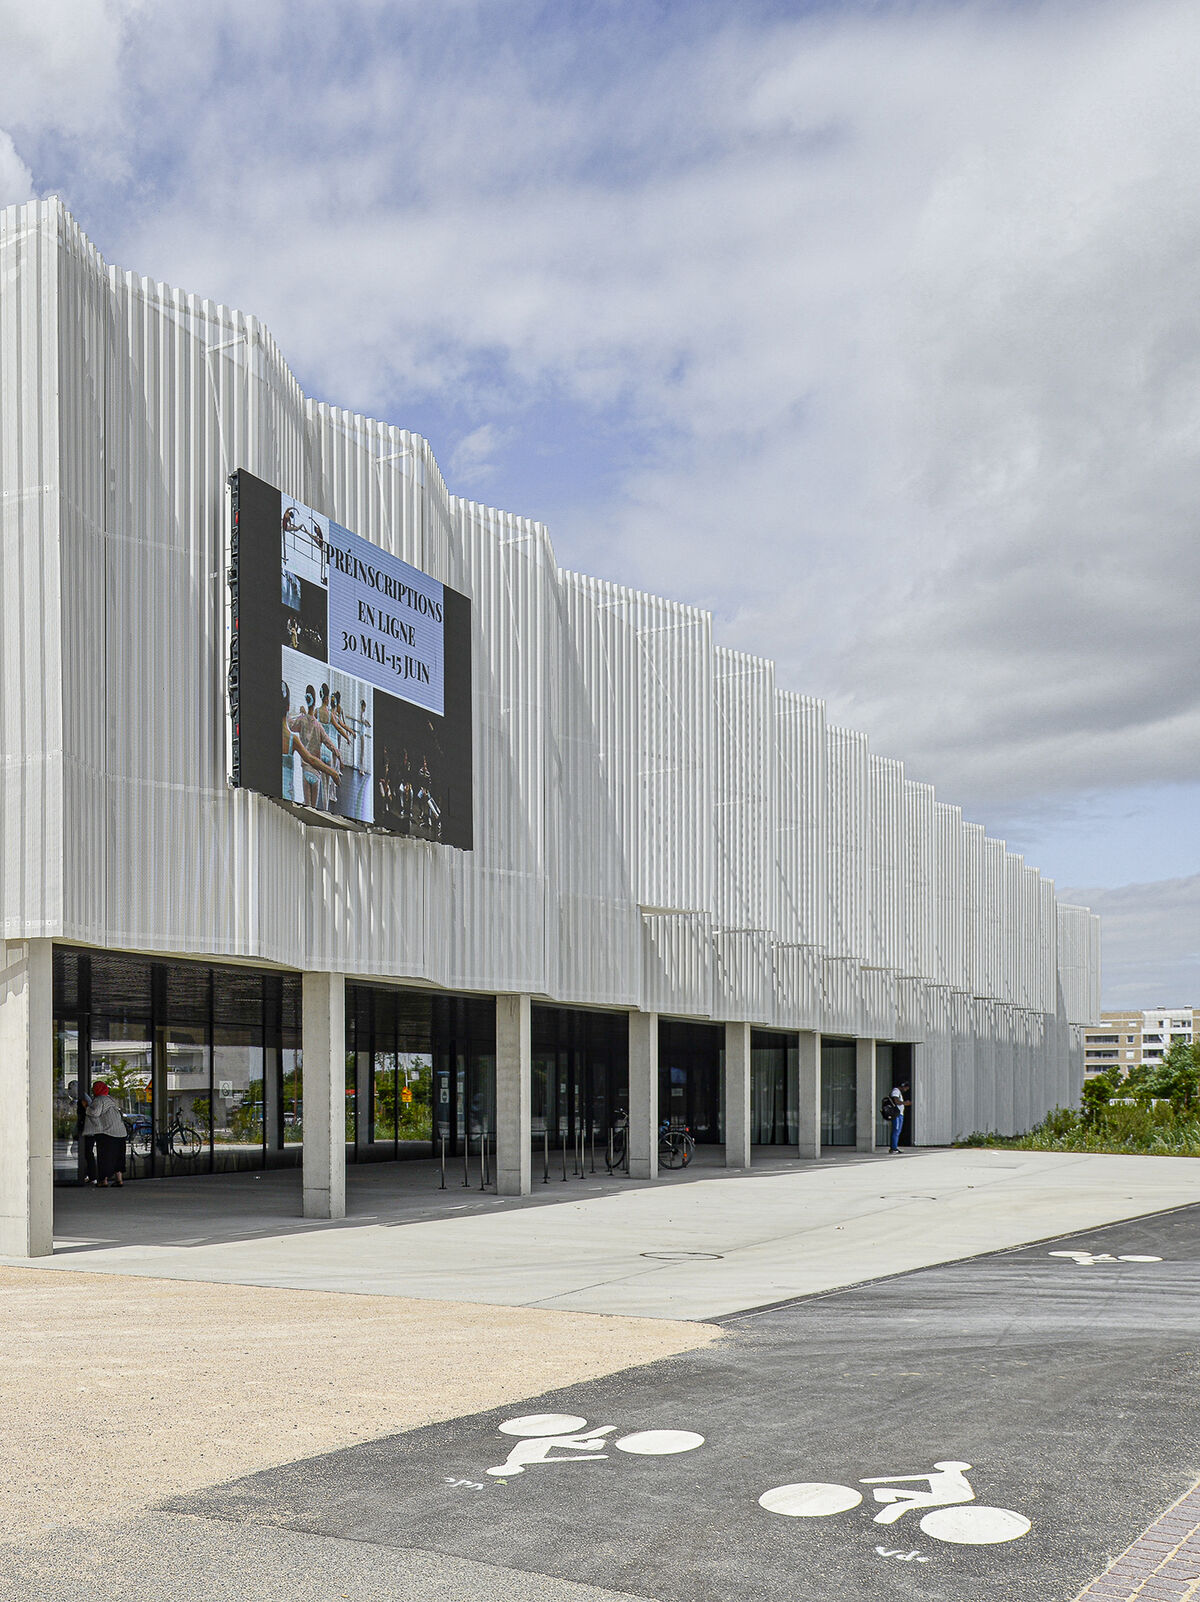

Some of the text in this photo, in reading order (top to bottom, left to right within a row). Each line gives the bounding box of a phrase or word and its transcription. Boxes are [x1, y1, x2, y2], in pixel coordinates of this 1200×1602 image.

[326, 543, 443, 623] PRÉINSCRIPTIONS
[358, 600, 416, 647] EN LIGNE
[341, 631, 430, 685] 30 MAI-15 JUIN
